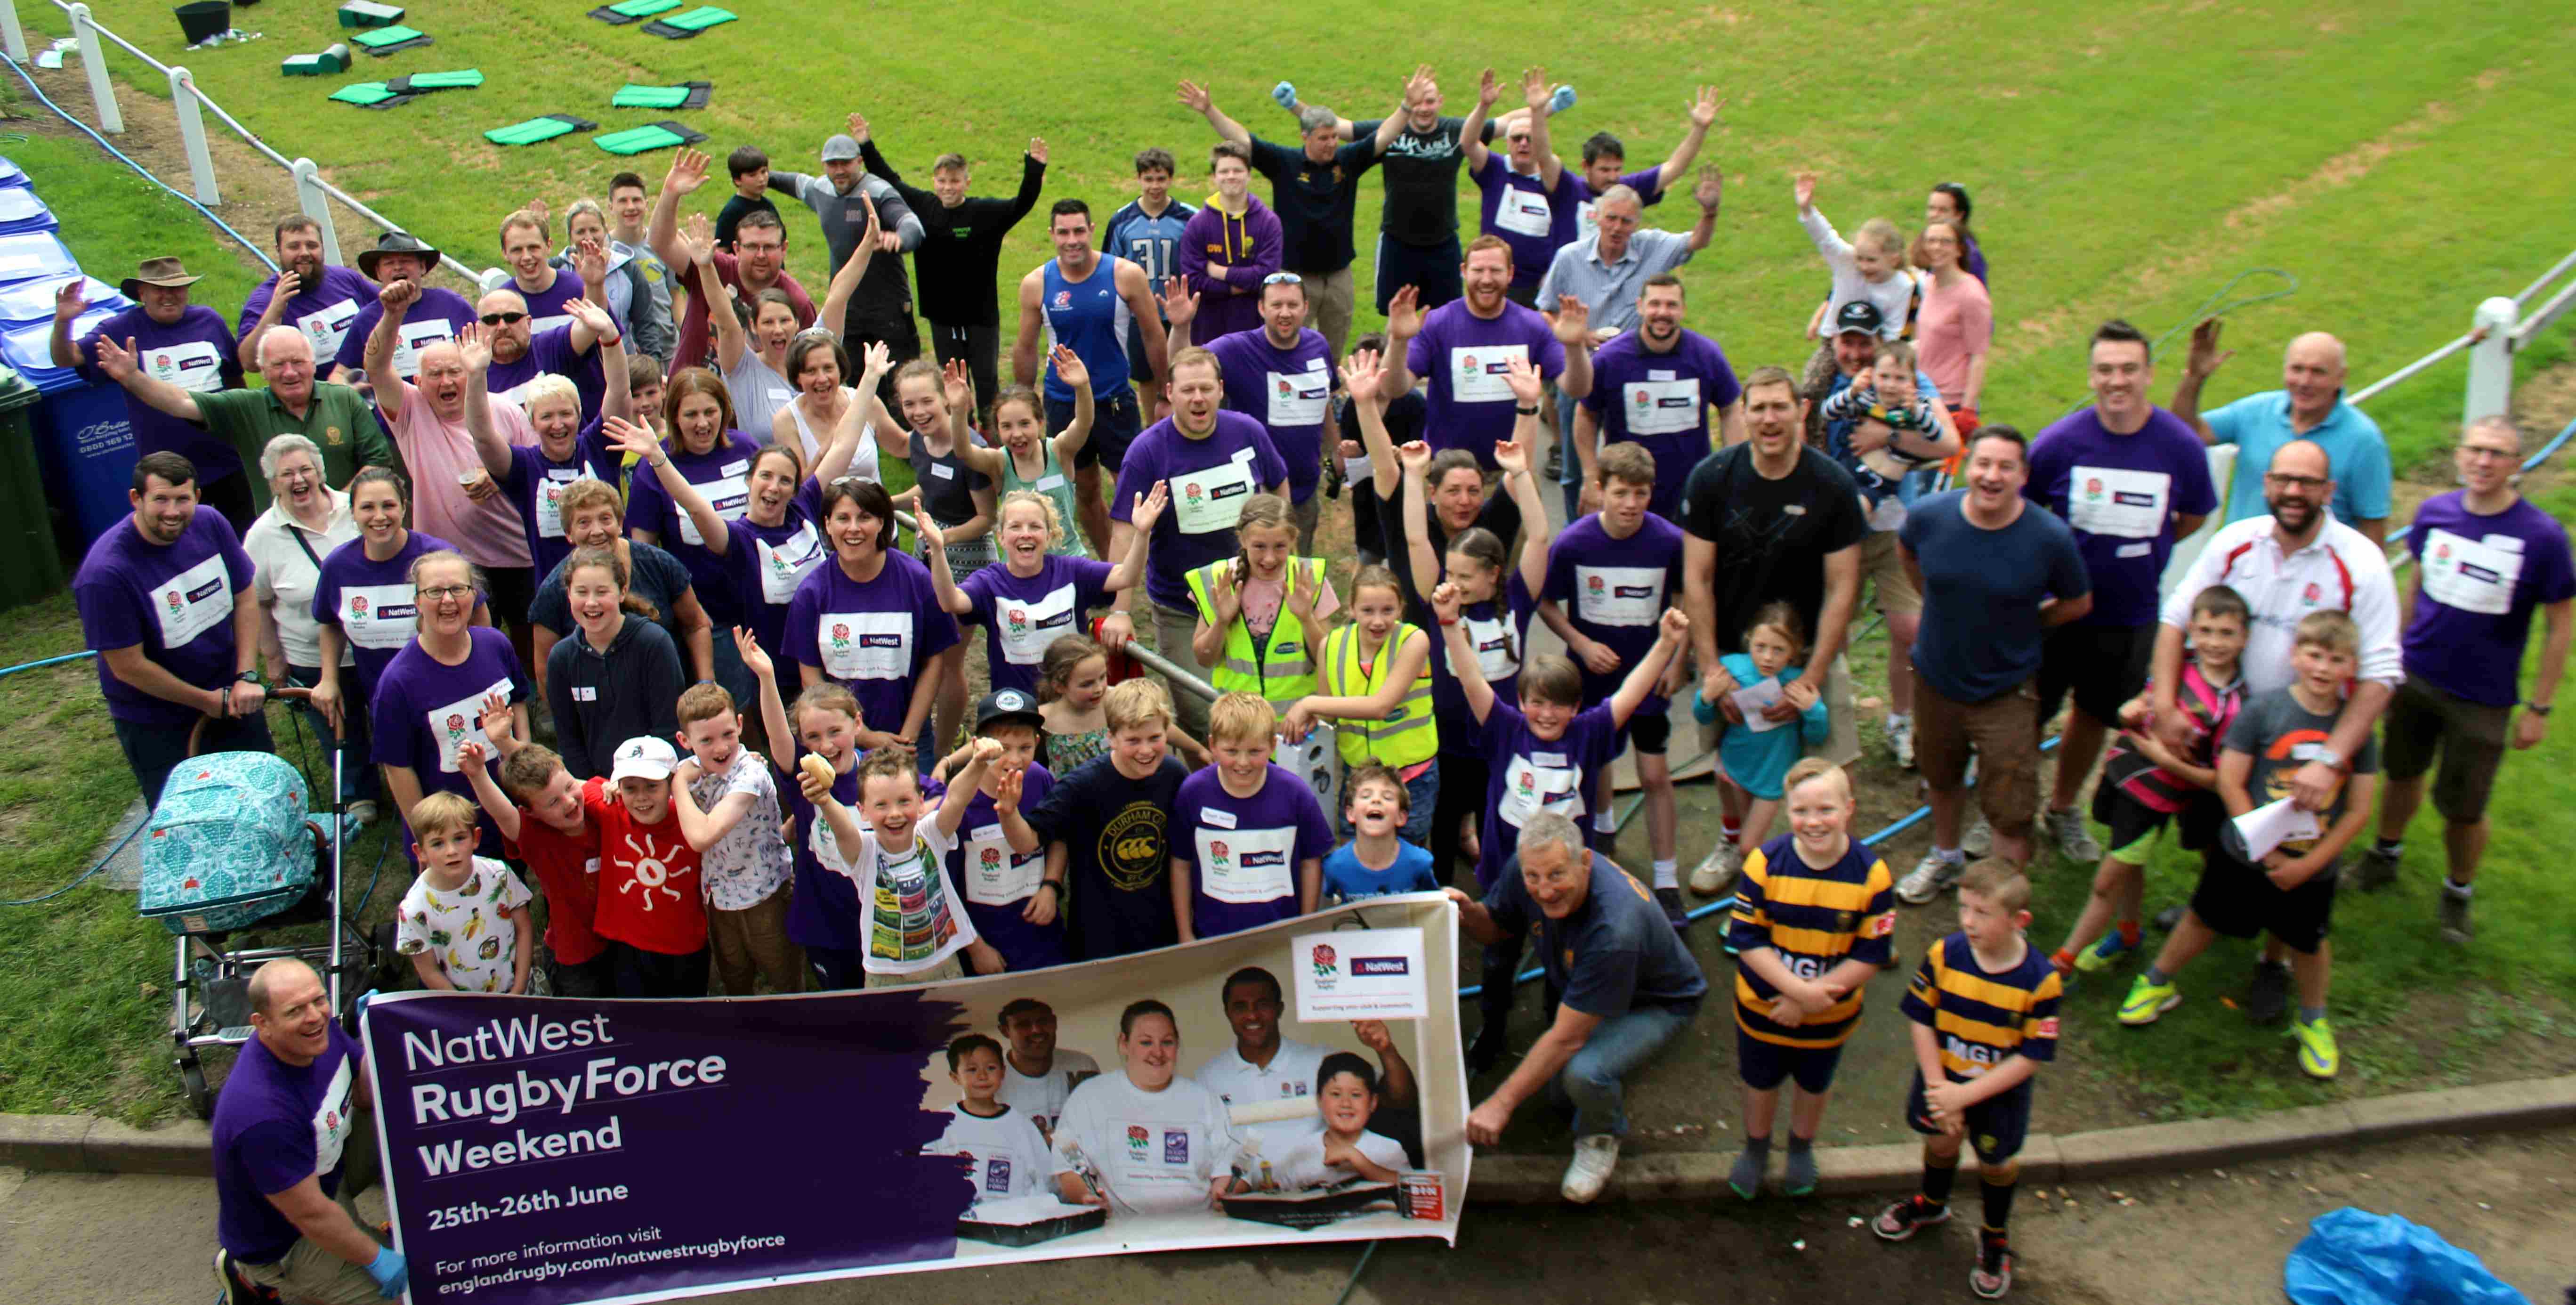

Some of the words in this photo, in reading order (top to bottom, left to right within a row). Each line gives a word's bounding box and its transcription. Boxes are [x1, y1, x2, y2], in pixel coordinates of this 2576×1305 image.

[1132, 239, 1172, 280] 31
[388, 608, 416, 616] NatWest
[870, 637, 898, 646] NatWest
[1107, 811, 1151, 837] DURHAM
[1253, 855, 1284, 864] NatWest
[1365, 962, 1405, 972] NatWest
[404, 1013, 614, 1071] NatWest
[412, 1055, 727, 1125] RugbyForce
[419, 1116, 622, 1176] Weekend
[428, 1189, 560, 1231] 25th-26th
[566, 1185, 629, 1207] June
[435, 1260, 466, 1275] For
[472, 1251, 517, 1268] more
[523, 1235, 622, 1259] information
[629, 1227, 662, 1245] visit
[439, 1235, 786, 1294] englandrugby.com/natwestrugbyforce
